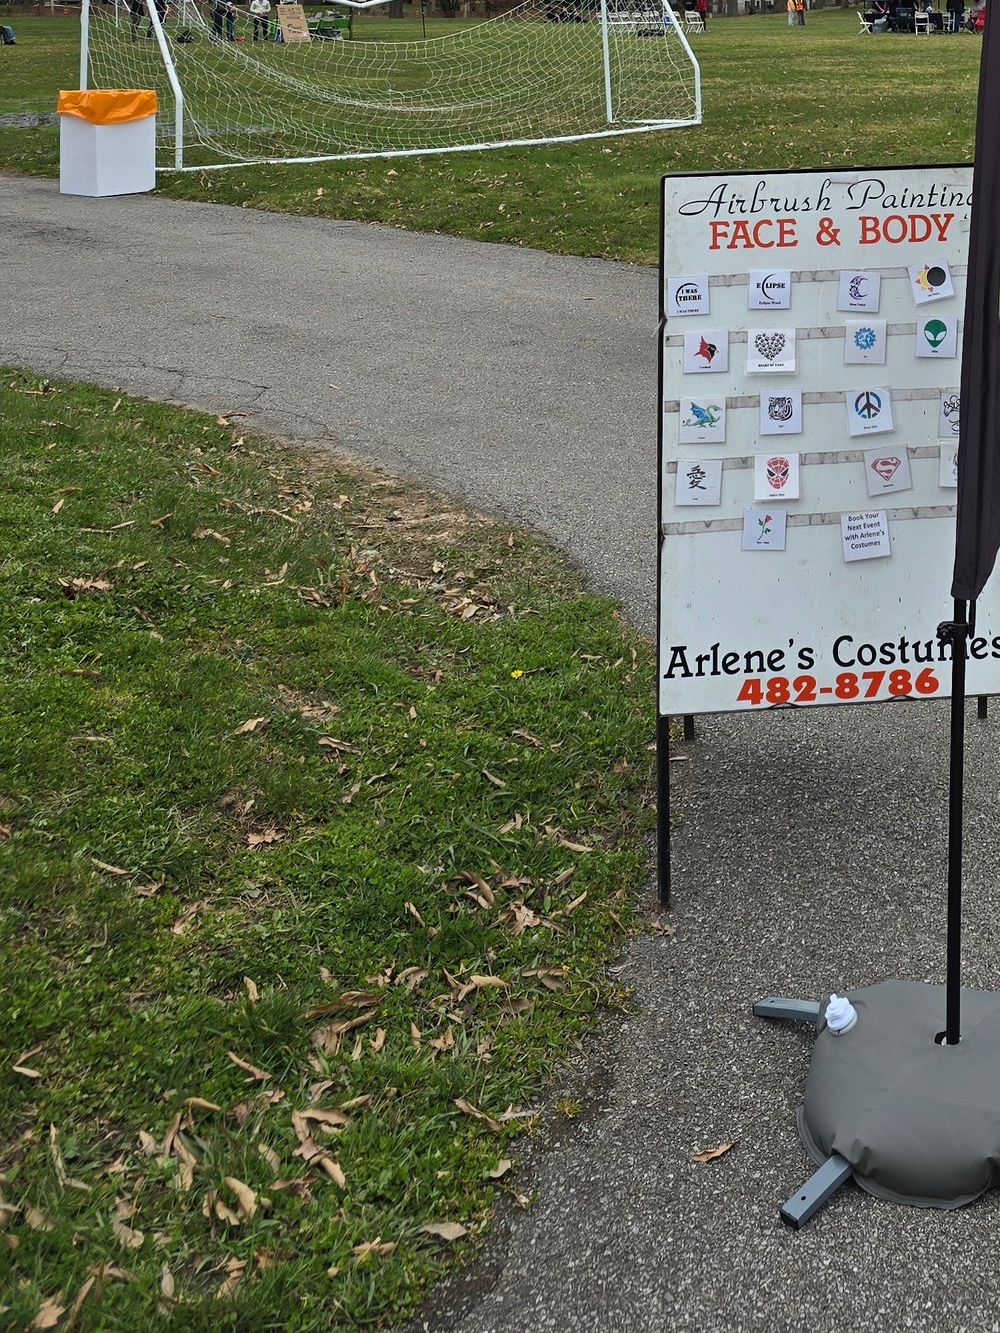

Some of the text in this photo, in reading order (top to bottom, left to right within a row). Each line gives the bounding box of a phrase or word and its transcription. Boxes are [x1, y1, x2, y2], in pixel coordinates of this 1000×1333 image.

[678, 178, 832, 218] Airbrush
[708, 213, 954, 250] FACE & BODY
[678, 294, 702, 302] THERE
[848, 513, 864, 522] Book
[863, 521, 881, 529] Event
[844, 529, 885, 541] with Arlene's
[850, 540, 881, 549] Costumes
[663, 638, 815, 679] Arlene's
[736, 667, 940, 705] 482-8786
